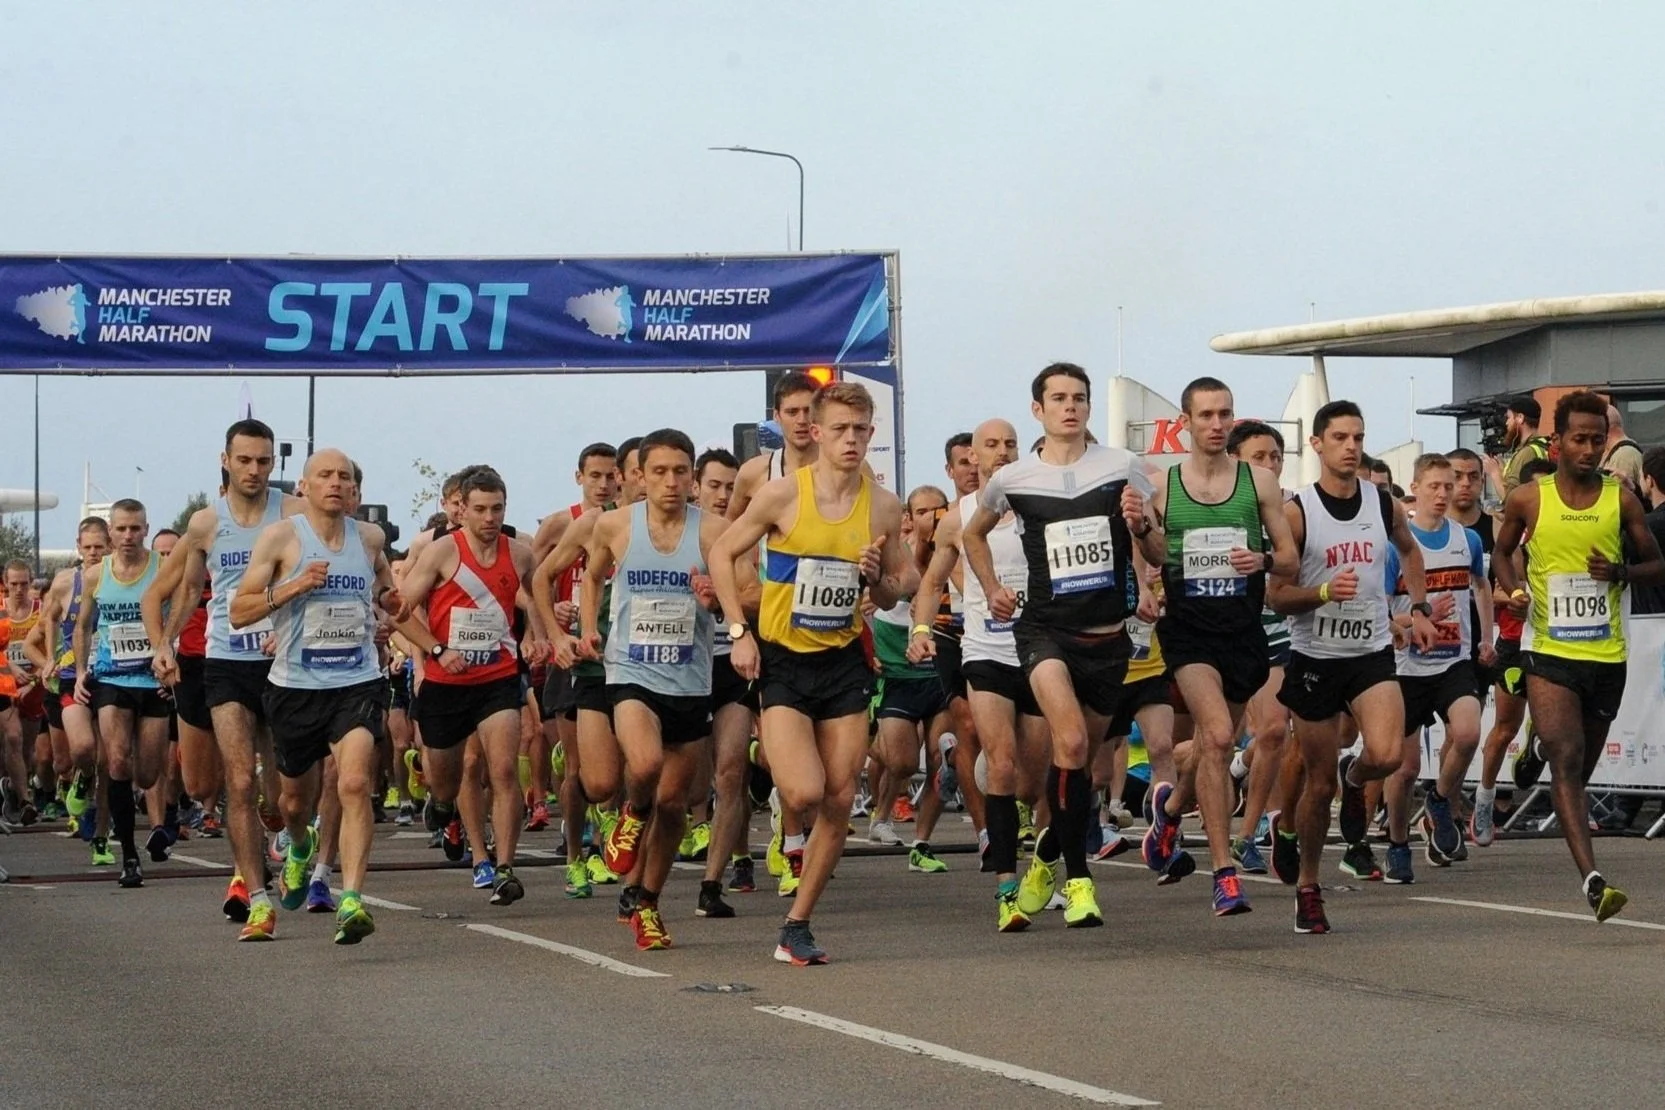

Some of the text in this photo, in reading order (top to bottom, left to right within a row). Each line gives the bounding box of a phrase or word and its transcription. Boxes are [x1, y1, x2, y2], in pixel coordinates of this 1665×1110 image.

[98, 288, 231, 306] MANCHESTER
[643, 287, 770, 305] MANCHESTER
[98, 307, 150, 323] HALF
[265, 282, 529, 352] START
[643, 307, 691, 323] HALF
[98, 324, 212, 342] MARATHON
[644, 323, 751, 341] MARATHON
[1560, 514, 1599, 523] saucony
[220, 551, 252, 567] BIDE
[1053, 541, 1110, 568] 11085
[1326, 541, 1373, 568] NYAC
[627, 570, 692, 587] BIDEFOR
[1196, 579, 1235, 596] 5124
[799, 583, 856, 607] 11088
[1553, 595, 1607, 617] 11098
[315, 629, 356, 639] Jenkin
[458, 631, 493, 641] RIGBY
[636, 622, 687, 634] ANTELL
[1318, 617, 1372, 640] 11005
[113, 639, 152, 654] 11039
[643, 645, 680, 664] 1188
